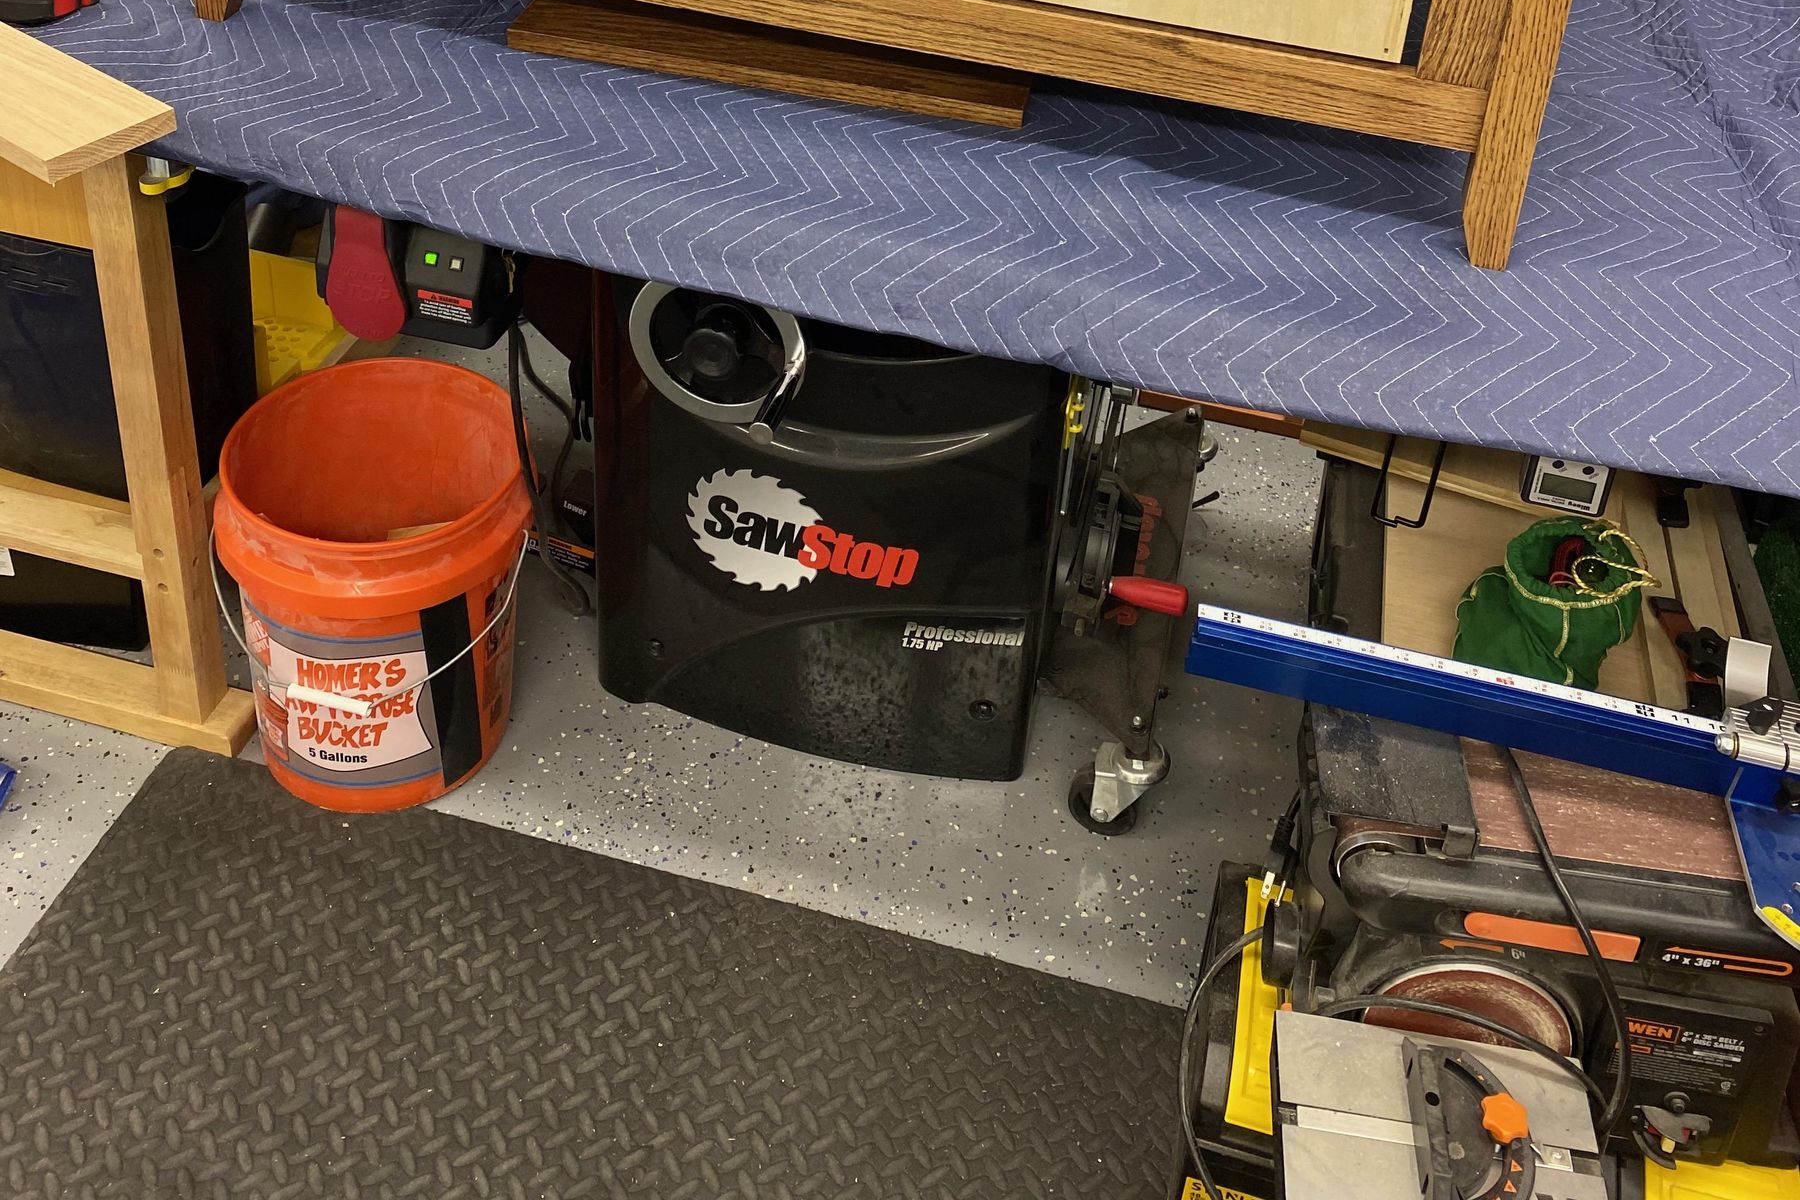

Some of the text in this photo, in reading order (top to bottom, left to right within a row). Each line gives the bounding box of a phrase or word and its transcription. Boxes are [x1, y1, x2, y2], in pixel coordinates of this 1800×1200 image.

[563, 500, 588, 517] Lower
[703, 494, 920, 588] SawStop
[903, 621, 1025, 647] Professional
[901, 637, 944, 652] 1.75 HP
[297, 716, 389, 749] BUCKET
[308, 747, 368, 763] 5 Gallons
[1662, 953, 1680, 963] 4"
[1693, 957, 1720, 968] 36"
[1628, 1021, 1673, 1039] WEN
[1693, 1038, 1713, 1046] DISC
[1713, 1040, 1746, 1052] SANDER
[1718, 1036, 1738, 1045] BELT
